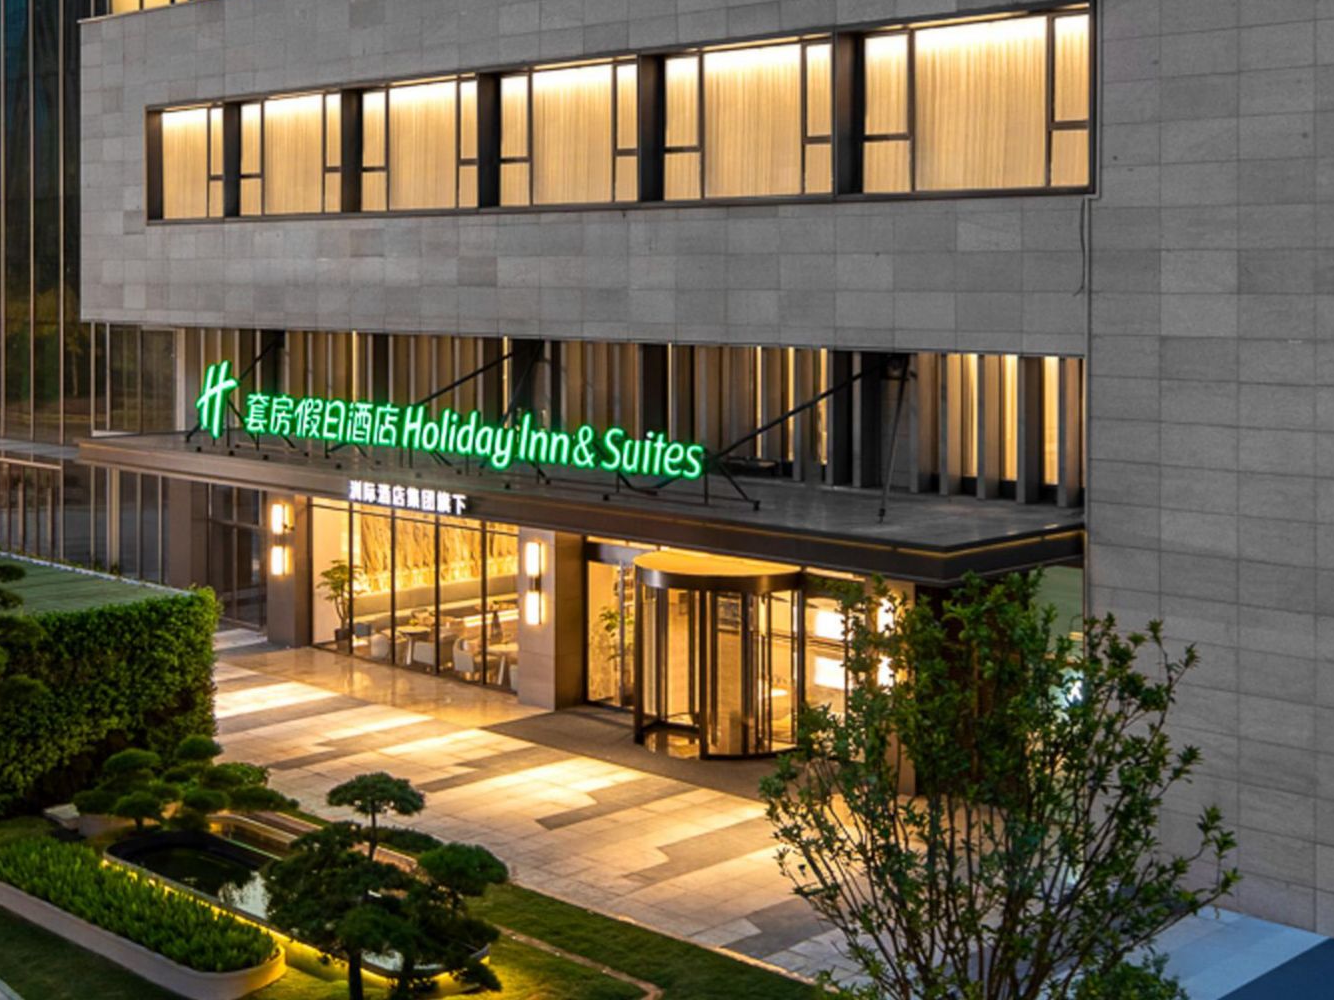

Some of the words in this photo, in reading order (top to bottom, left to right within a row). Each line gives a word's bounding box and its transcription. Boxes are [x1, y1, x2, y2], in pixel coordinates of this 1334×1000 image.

[244, 392, 399, 446] 套房假日酒店
[402, 405, 516, 469] Holiday
[519, 413, 569, 463] Inn
[571, 426, 597, 468] &
[601, 428, 703, 479] Suites
[349, 480, 467, 515] 洲际酒店集团旗下
